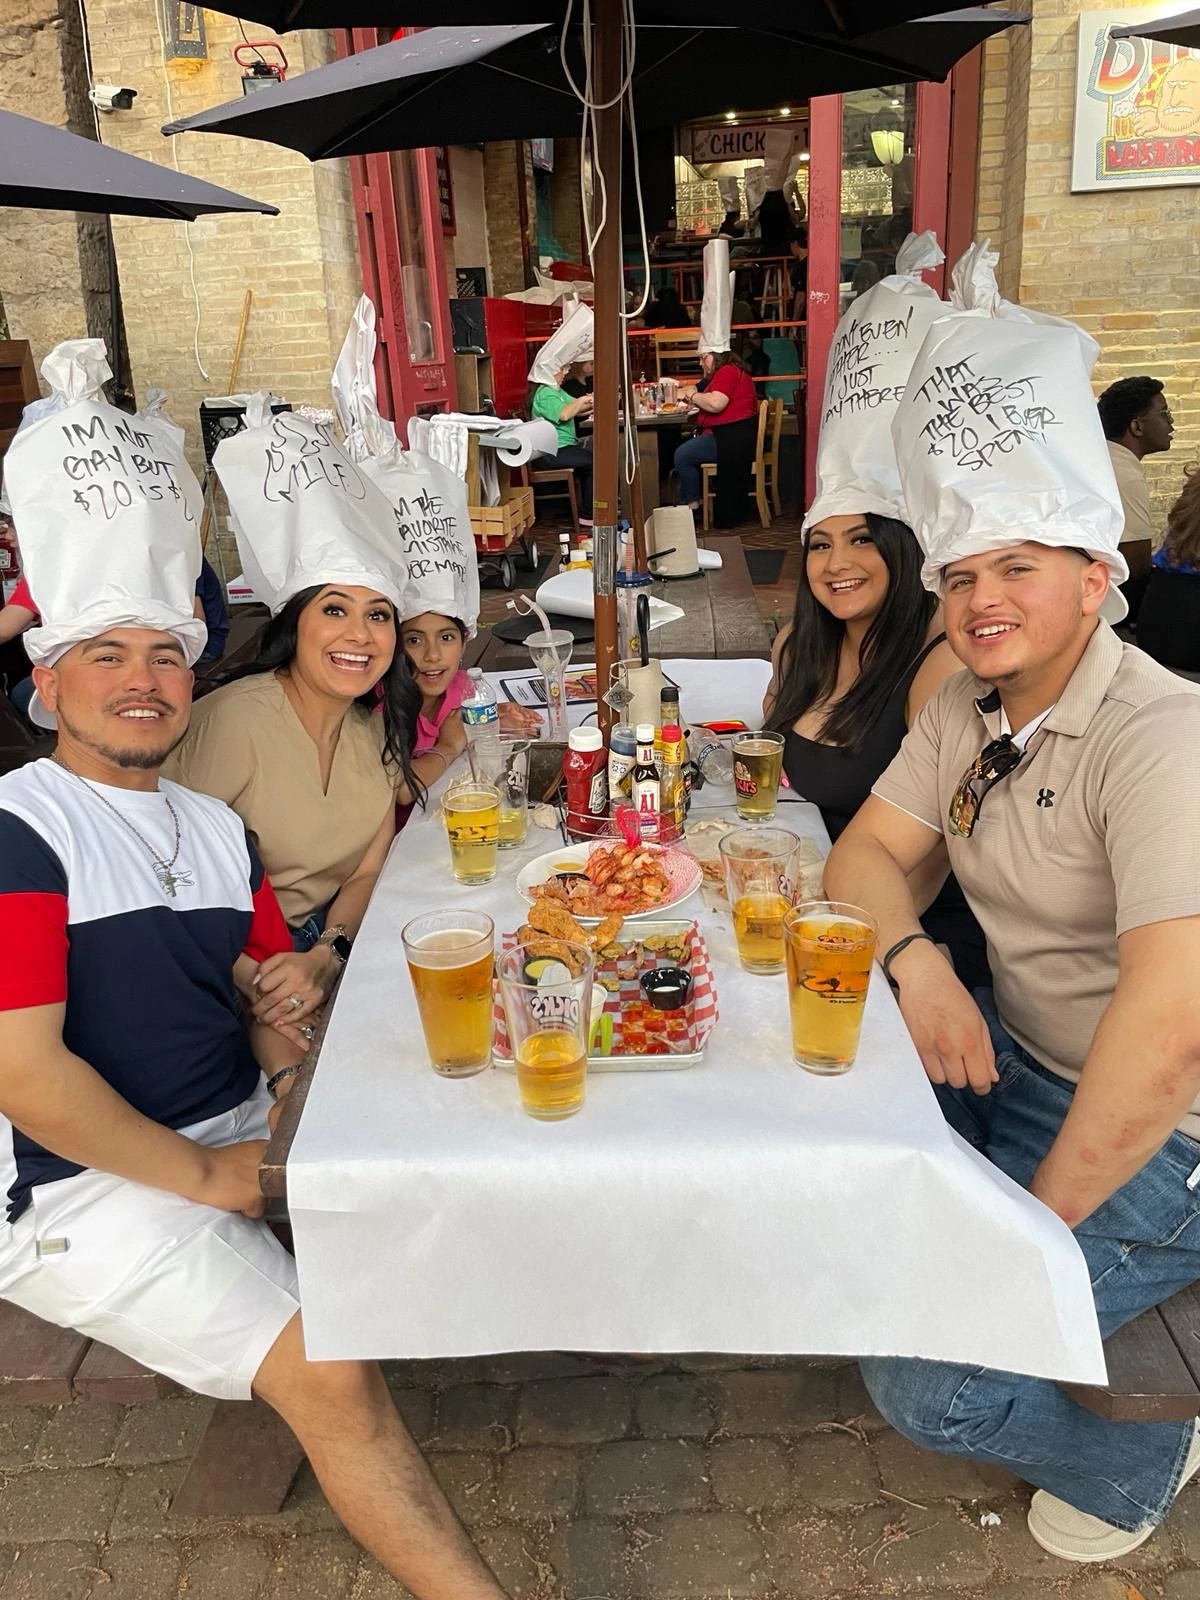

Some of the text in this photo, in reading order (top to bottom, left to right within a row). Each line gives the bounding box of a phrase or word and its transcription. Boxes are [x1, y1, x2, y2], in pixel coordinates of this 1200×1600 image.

[710, 131, 766, 155] CHICK
[859, 305, 914, 343] EVEN
[838, 363, 884, 400] JUST
[912, 351, 982, 403] THAT
[938, 376, 1004, 412] WAS
[918, 375, 1045, 441] THE BEST
[1001, 404, 1065, 430] EVER
[115, 417, 154, 453] NOT
[63, 445, 177, 488] GAY BUT
[73, 480, 132, 520] $20
[411, 488, 444, 517] THE
[397, 516, 457, 541] AVORITE
